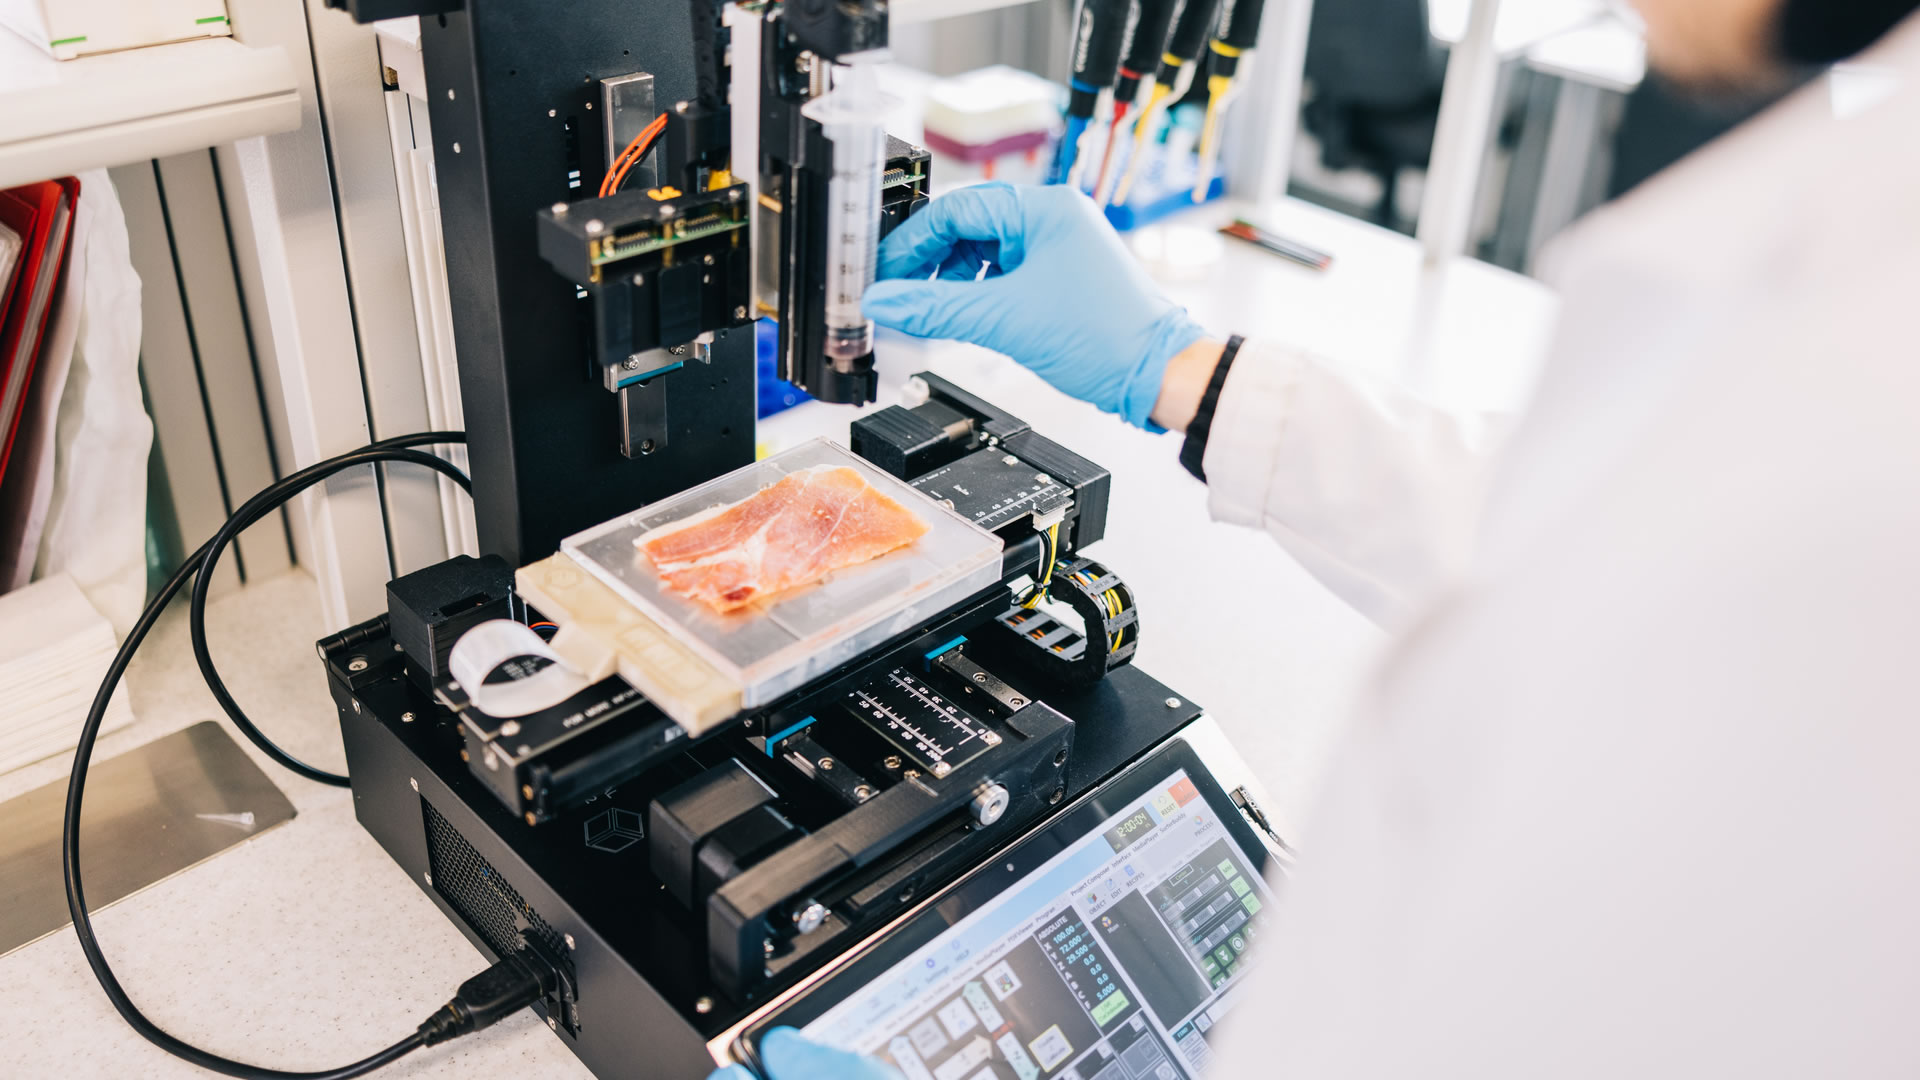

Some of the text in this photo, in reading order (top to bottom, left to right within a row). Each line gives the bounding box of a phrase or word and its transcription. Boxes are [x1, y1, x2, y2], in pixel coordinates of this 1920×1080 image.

[903, 676, 915, 684] 50
[918, 686, 929, 695] 40
[931, 695, 943, 704] 30
[945, 706, 958, 715] 20
[859, 700, 870, 709] 50
[873, 710, 884, 719] 60
[887, 720, 899, 730] 70
[901, 731, 913, 740] 80
[915, 742, 928, 751] 90
[1161, 803, 1176, 817] RESET
[1194, 821, 1214, 837] PROCESS
[1071, 881, 1087, 896] Project
[1088, 867, 1110, 886] Composer
[1111, 852, 1132, 867] Interface
[1089, 900, 1106, 915] OBJECT
[1110, 888, 1122, 899] EDIT
[1125, 872, 1145, 888] RECIPES
[1038, 915, 1068, 940] ABSOLUTE
[1044, 942, 1052, 951] X
[1050, 952, 1057, 960] Y
[1057, 961, 1065, 971] Z
[1064, 954, 1095, 980] A 0.0
[1090, 963, 1102, 976] 0.0
[1078, 973, 1109, 999] C 0.0
